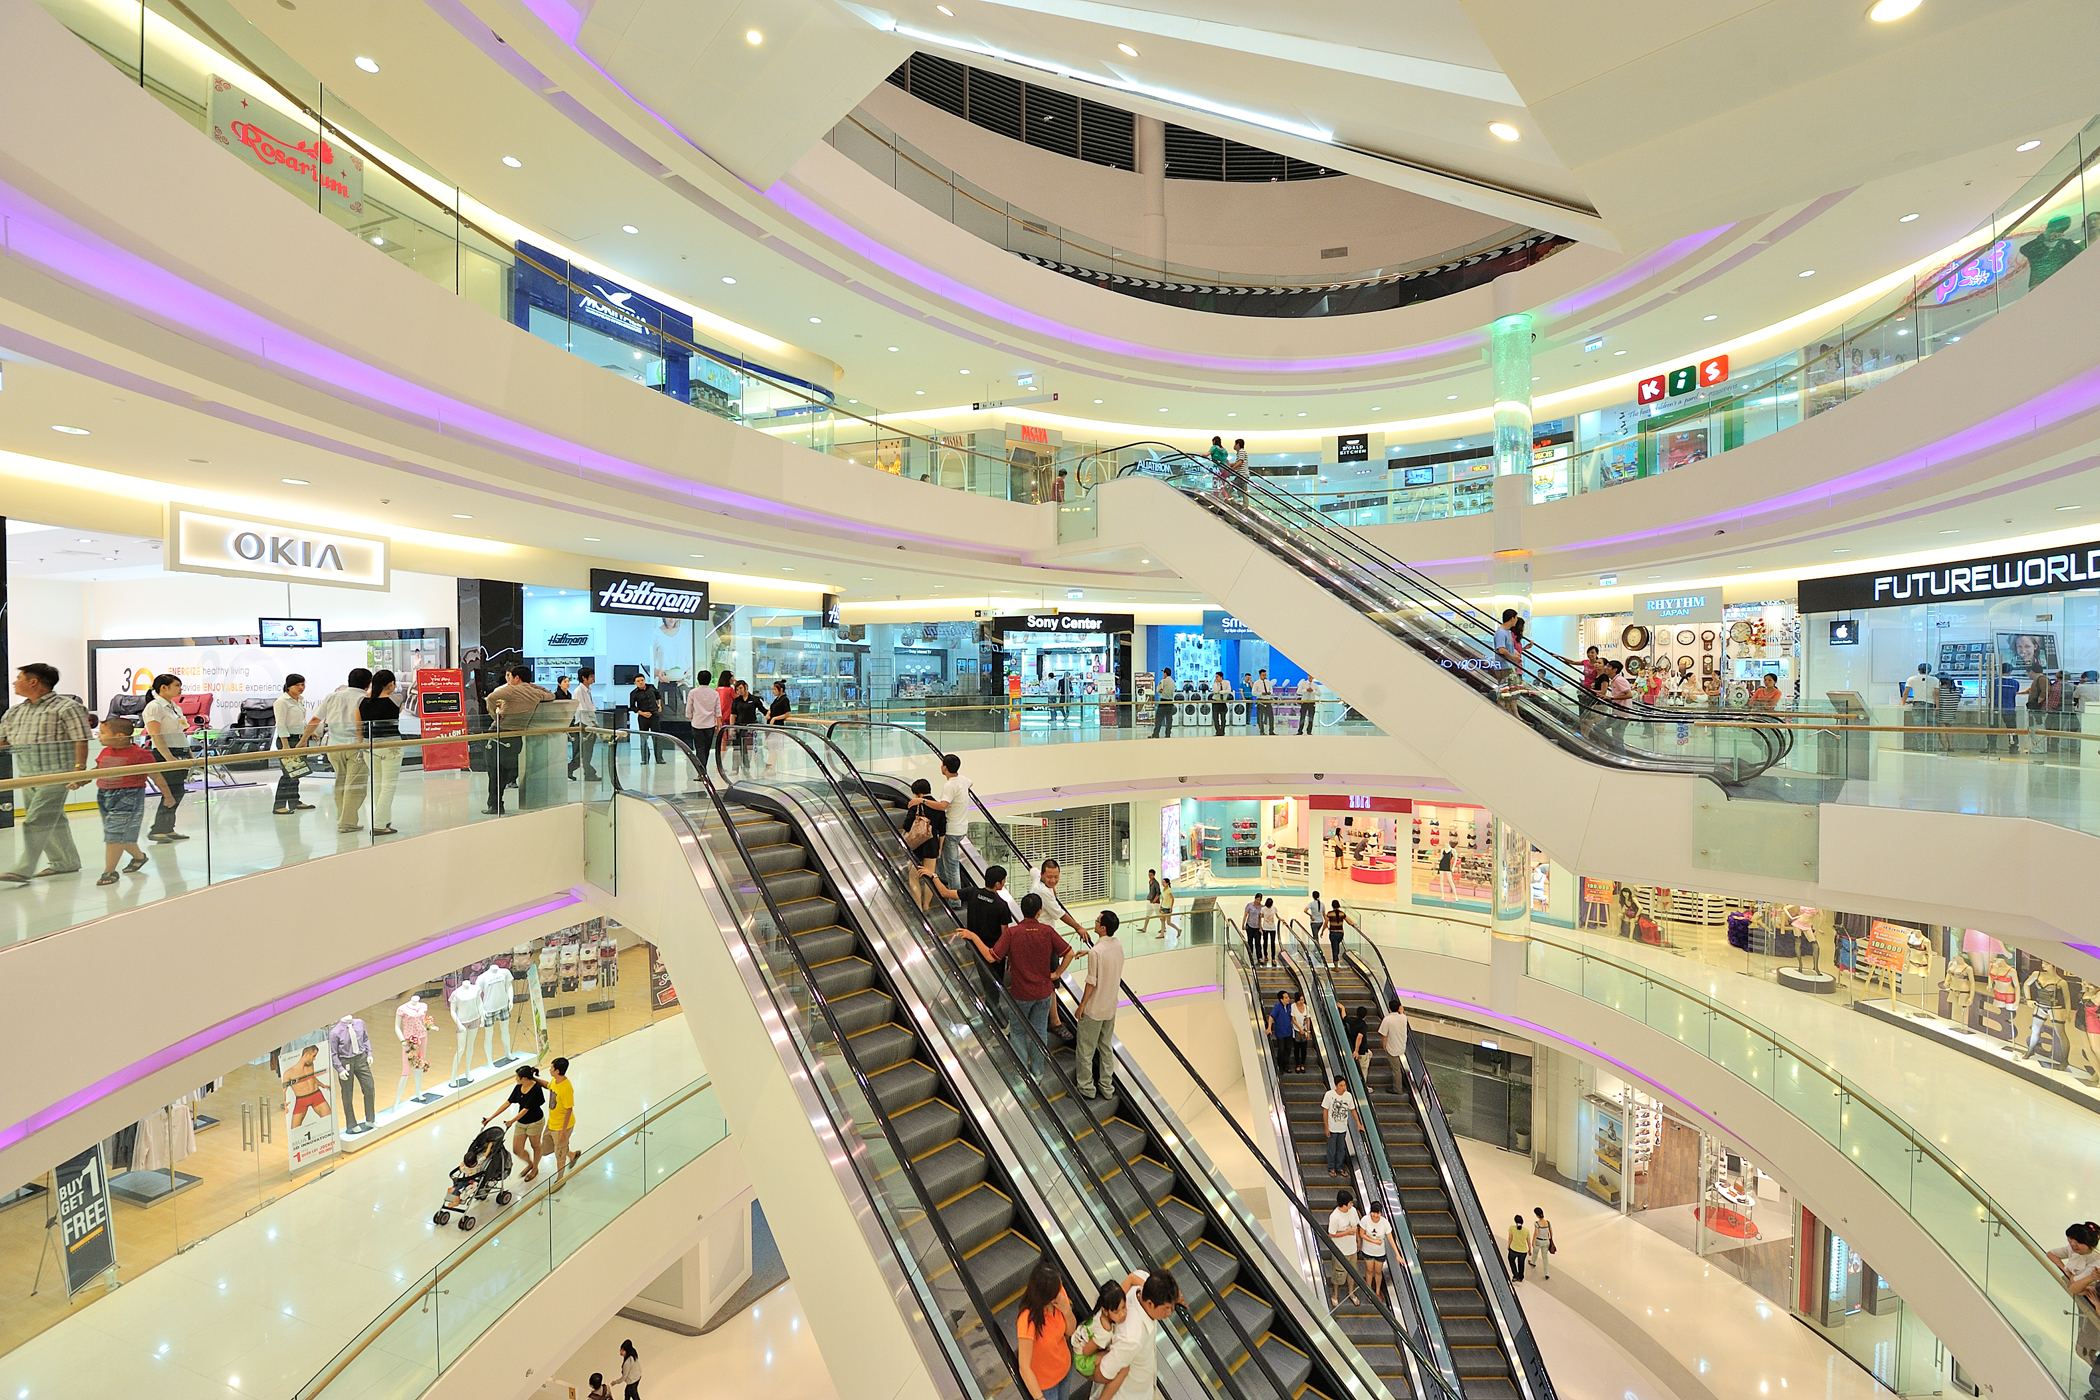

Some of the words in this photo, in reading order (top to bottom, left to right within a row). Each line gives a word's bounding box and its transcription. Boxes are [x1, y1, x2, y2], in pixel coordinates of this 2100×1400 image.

[231, 121, 349, 198] Rosarium
[1022, 425, 1048, 444] PASAYA
[234, 531, 344, 571] OKIA
[1646, 595, 1706, 611] RHYTHM
[1659, 609, 1690, 618] JAPAN
[1027, 615, 1059, 631] Sony
[1061, 616, 1103, 630] Center
[1445, 622, 1475, 630] Krea
[803, 642, 821, 650] BRAVIA
[168, 667, 201, 675] ENERGIZE
[203, 666, 229, 677] healthy
[231, 666, 250, 676] living
[203, 682, 244, 692] ENJOYABLE
[216, 699, 241, 710] Suppor
[293, 1152, 301, 1163] 1
[59, 1174, 84, 1201] BUY
[82, 1156, 100, 1197] 1
[61, 1190, 85, 1216] GET
[62, 1197, 106, 1247] FREE
[1728, 1216, 1762, 1241] ecco
